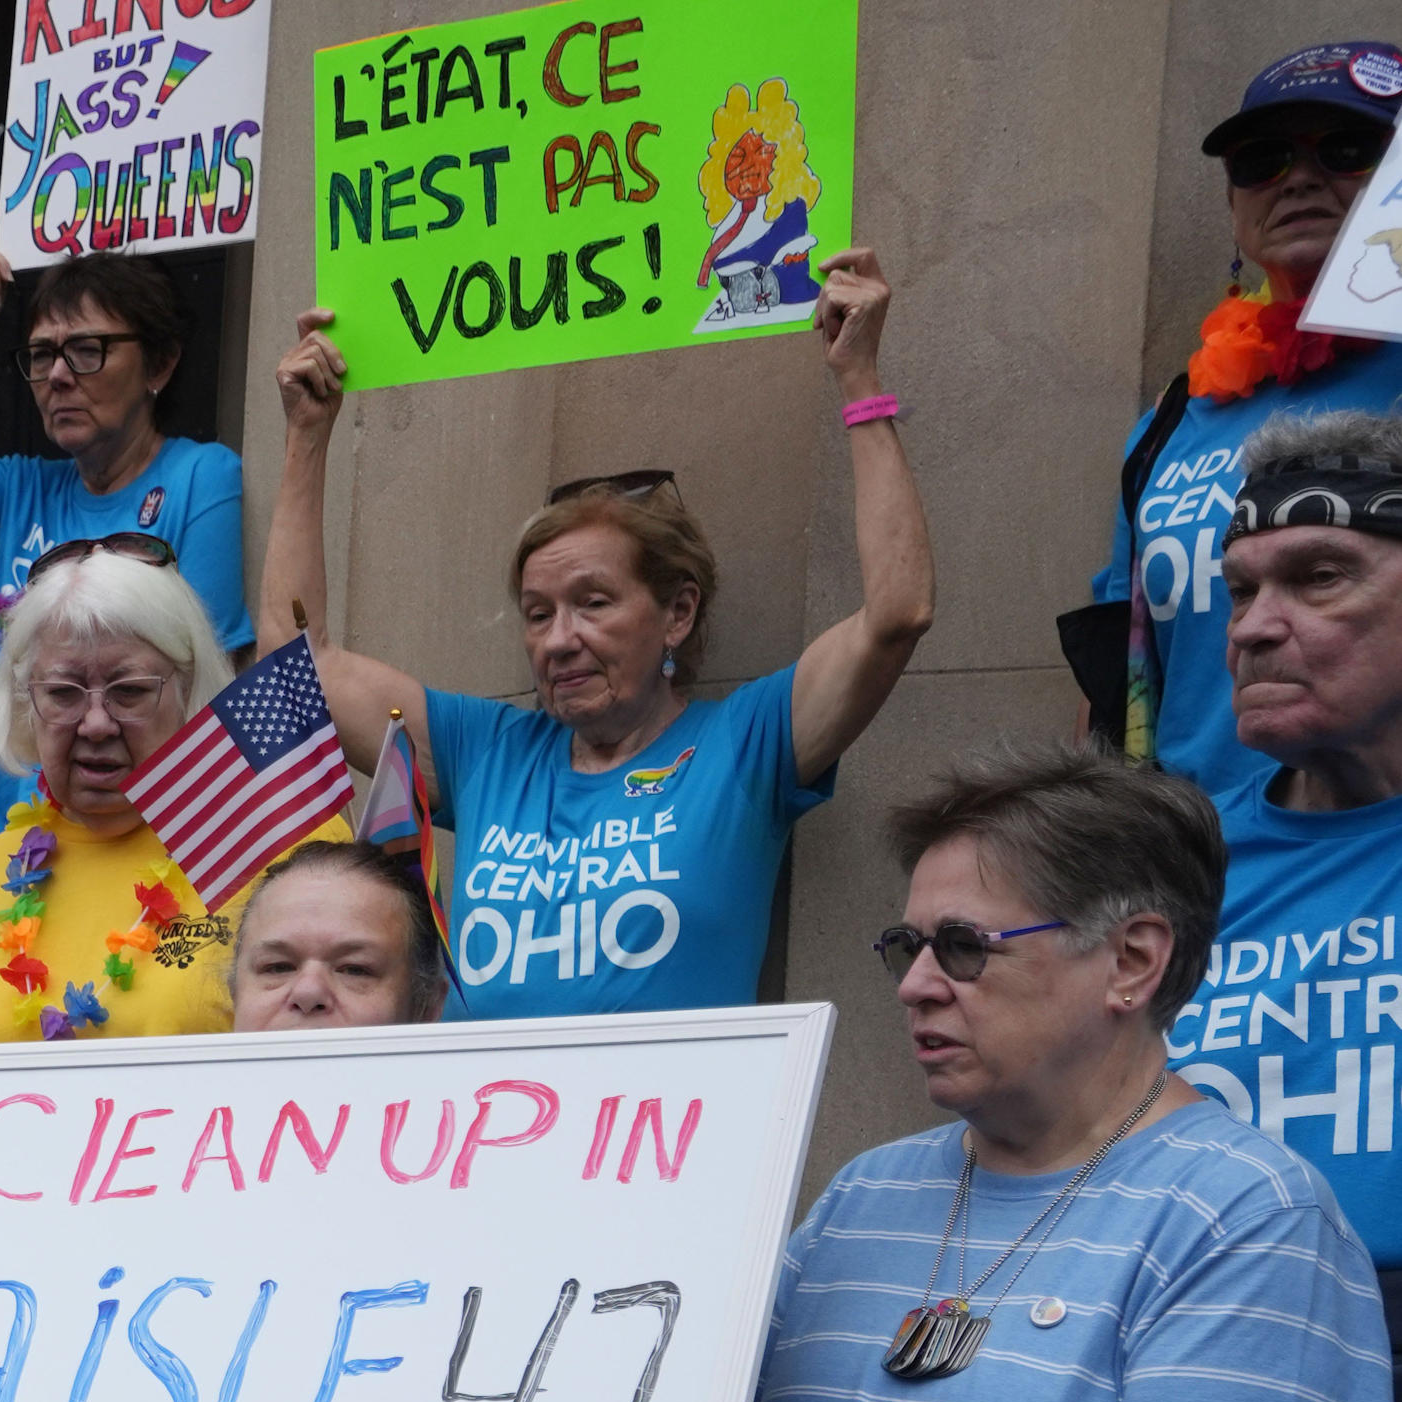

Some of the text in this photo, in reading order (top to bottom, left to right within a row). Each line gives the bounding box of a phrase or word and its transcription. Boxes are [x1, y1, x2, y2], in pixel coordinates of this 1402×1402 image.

[93, 35, 164, 73] BUT
[542, 17, 644, 105] CE
[1279, 76, 1339, 91] ALASKA
[1364, 78, 1392, 93] TRUMP
[1366, 52, 1400, 69] PROUD
[6, 40, 212, 214] YASS!
[542, 121, 662, 214] PAS
[32, 120, 261, 257] QUEENS
[465, 844, 680, 902] CENTRAL
[160, 921, 214, 940] UNITED
[459, 889, 681, 986] OHIO
[1163, 974, 1402, 1060] CENTR
[379, 1080, 559, 1191] UP
[581, 1095, 703, 1184] IN
